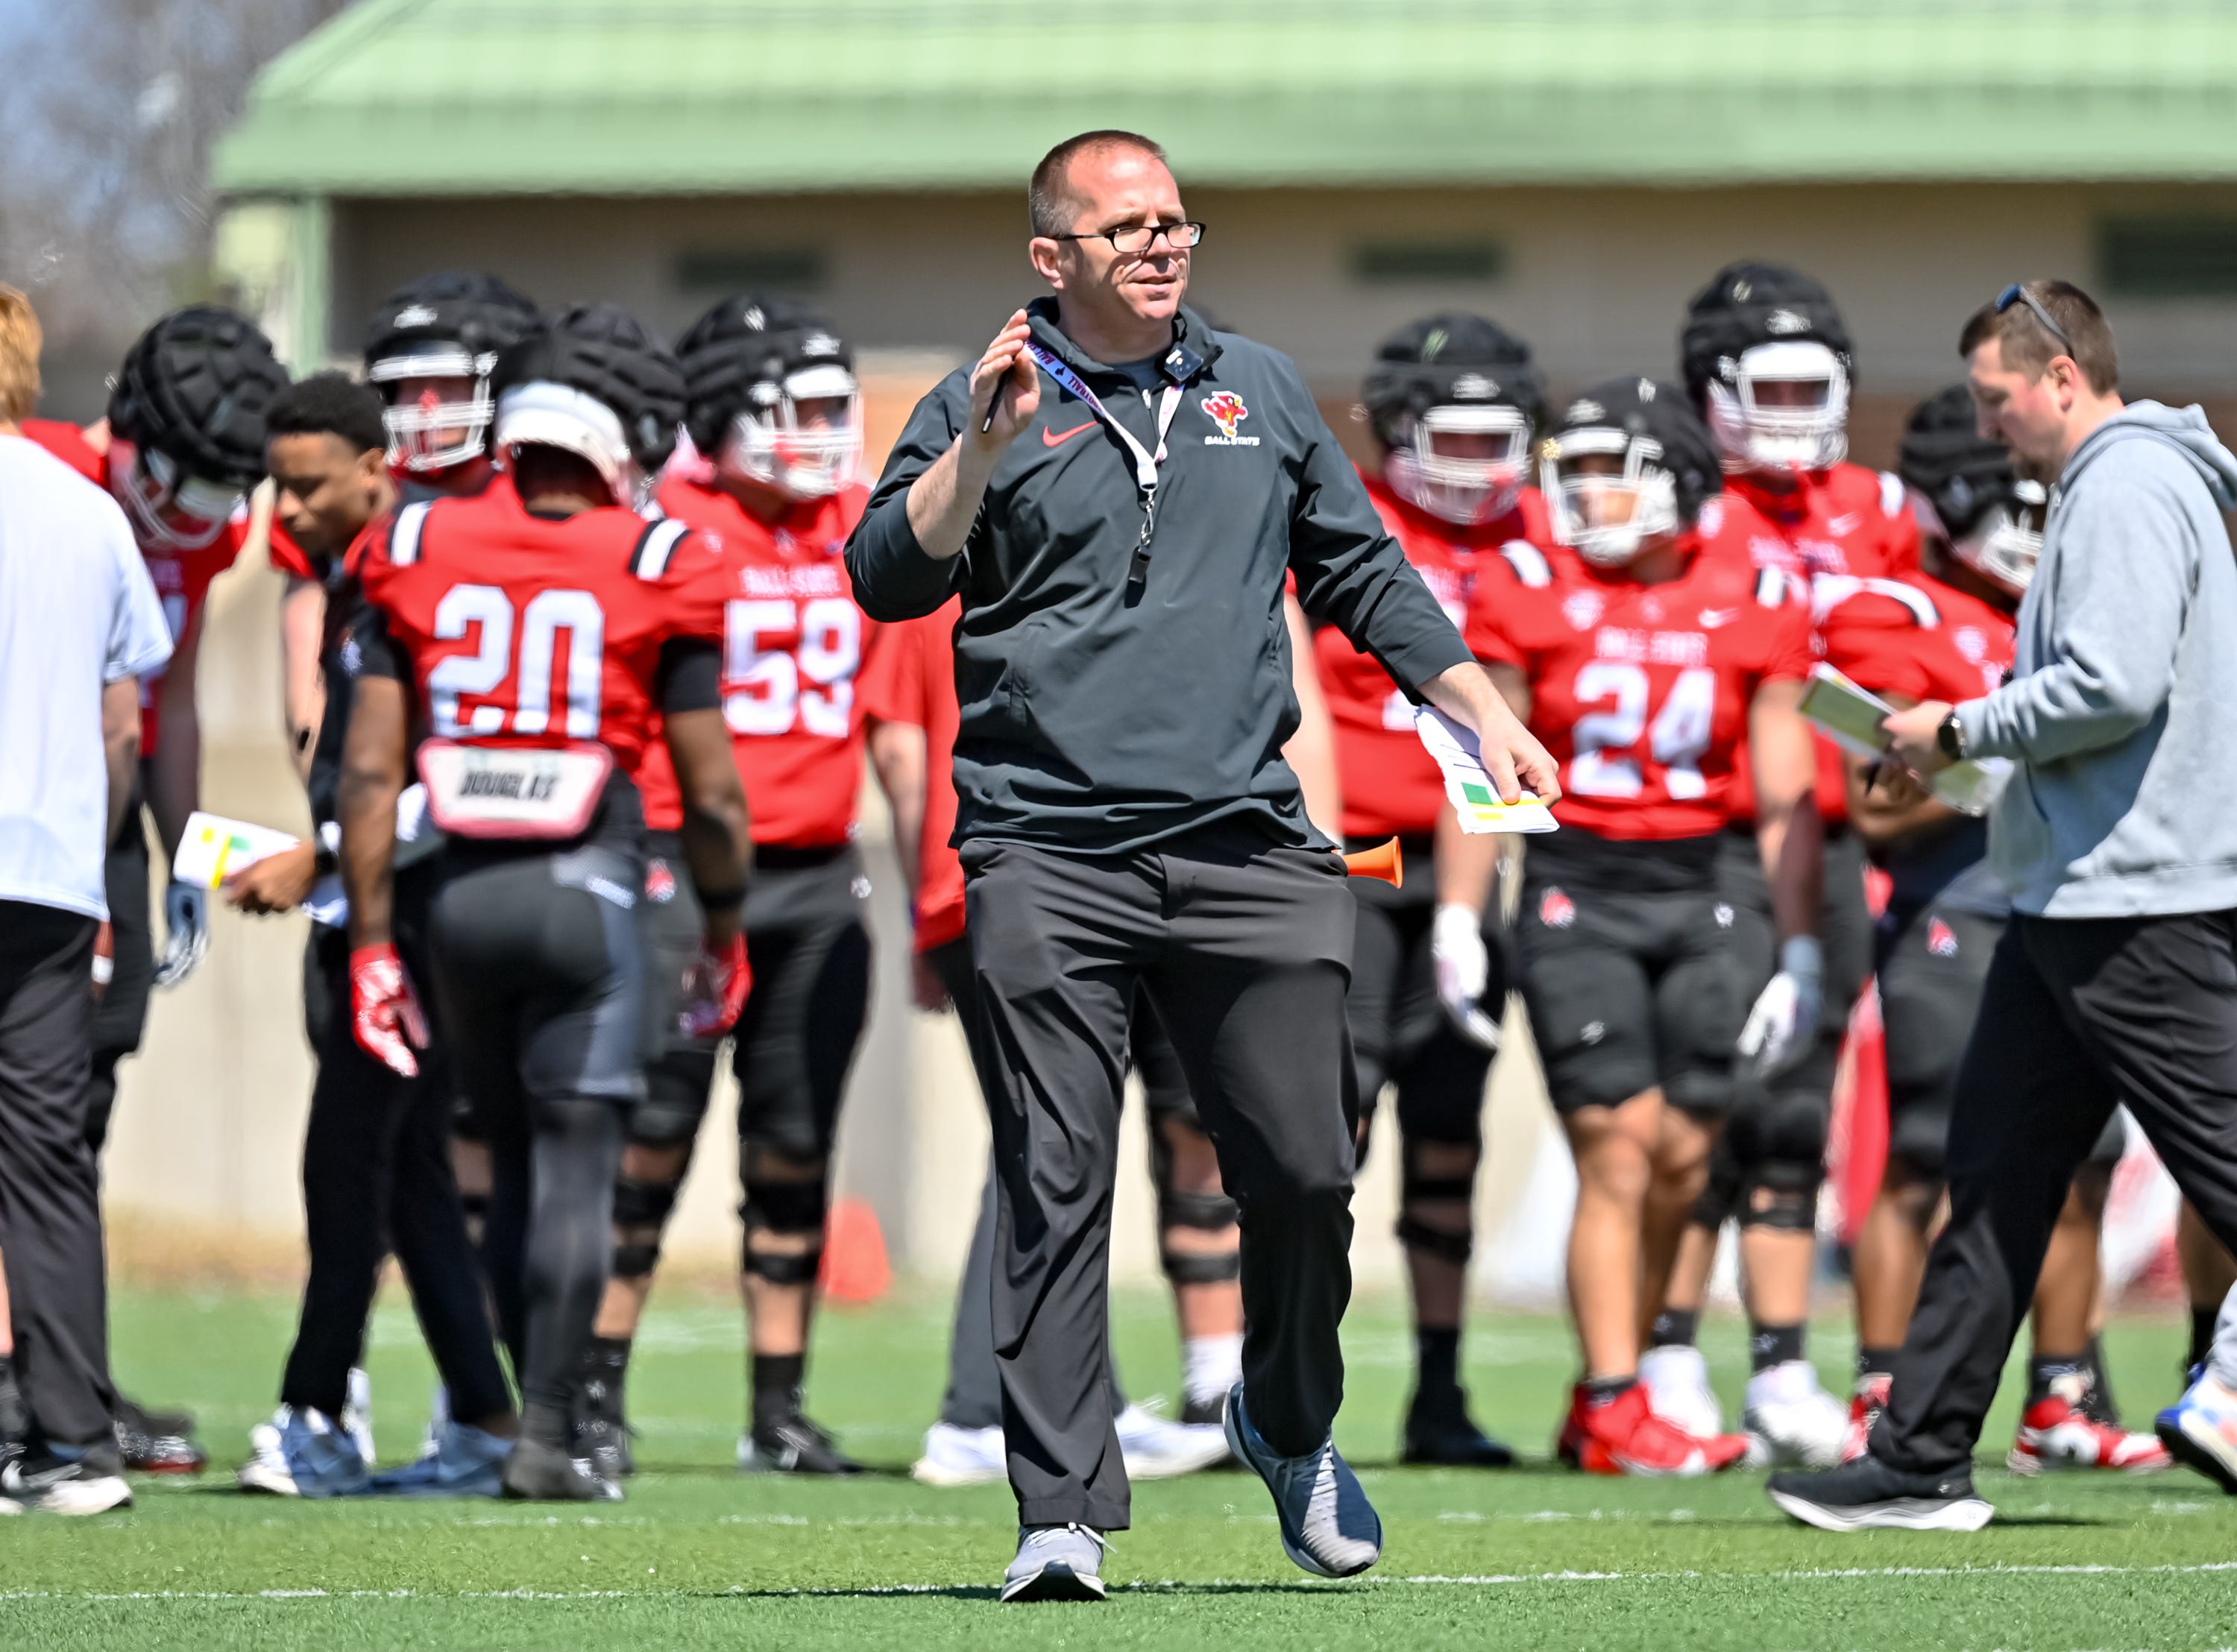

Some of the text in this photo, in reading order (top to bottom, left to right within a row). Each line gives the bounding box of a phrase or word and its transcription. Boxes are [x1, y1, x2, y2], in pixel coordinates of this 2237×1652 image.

[428, 583, 605, 737] 20
[722, 599, 860, 737] 59
[1569, 662, 1717, 800] 24
